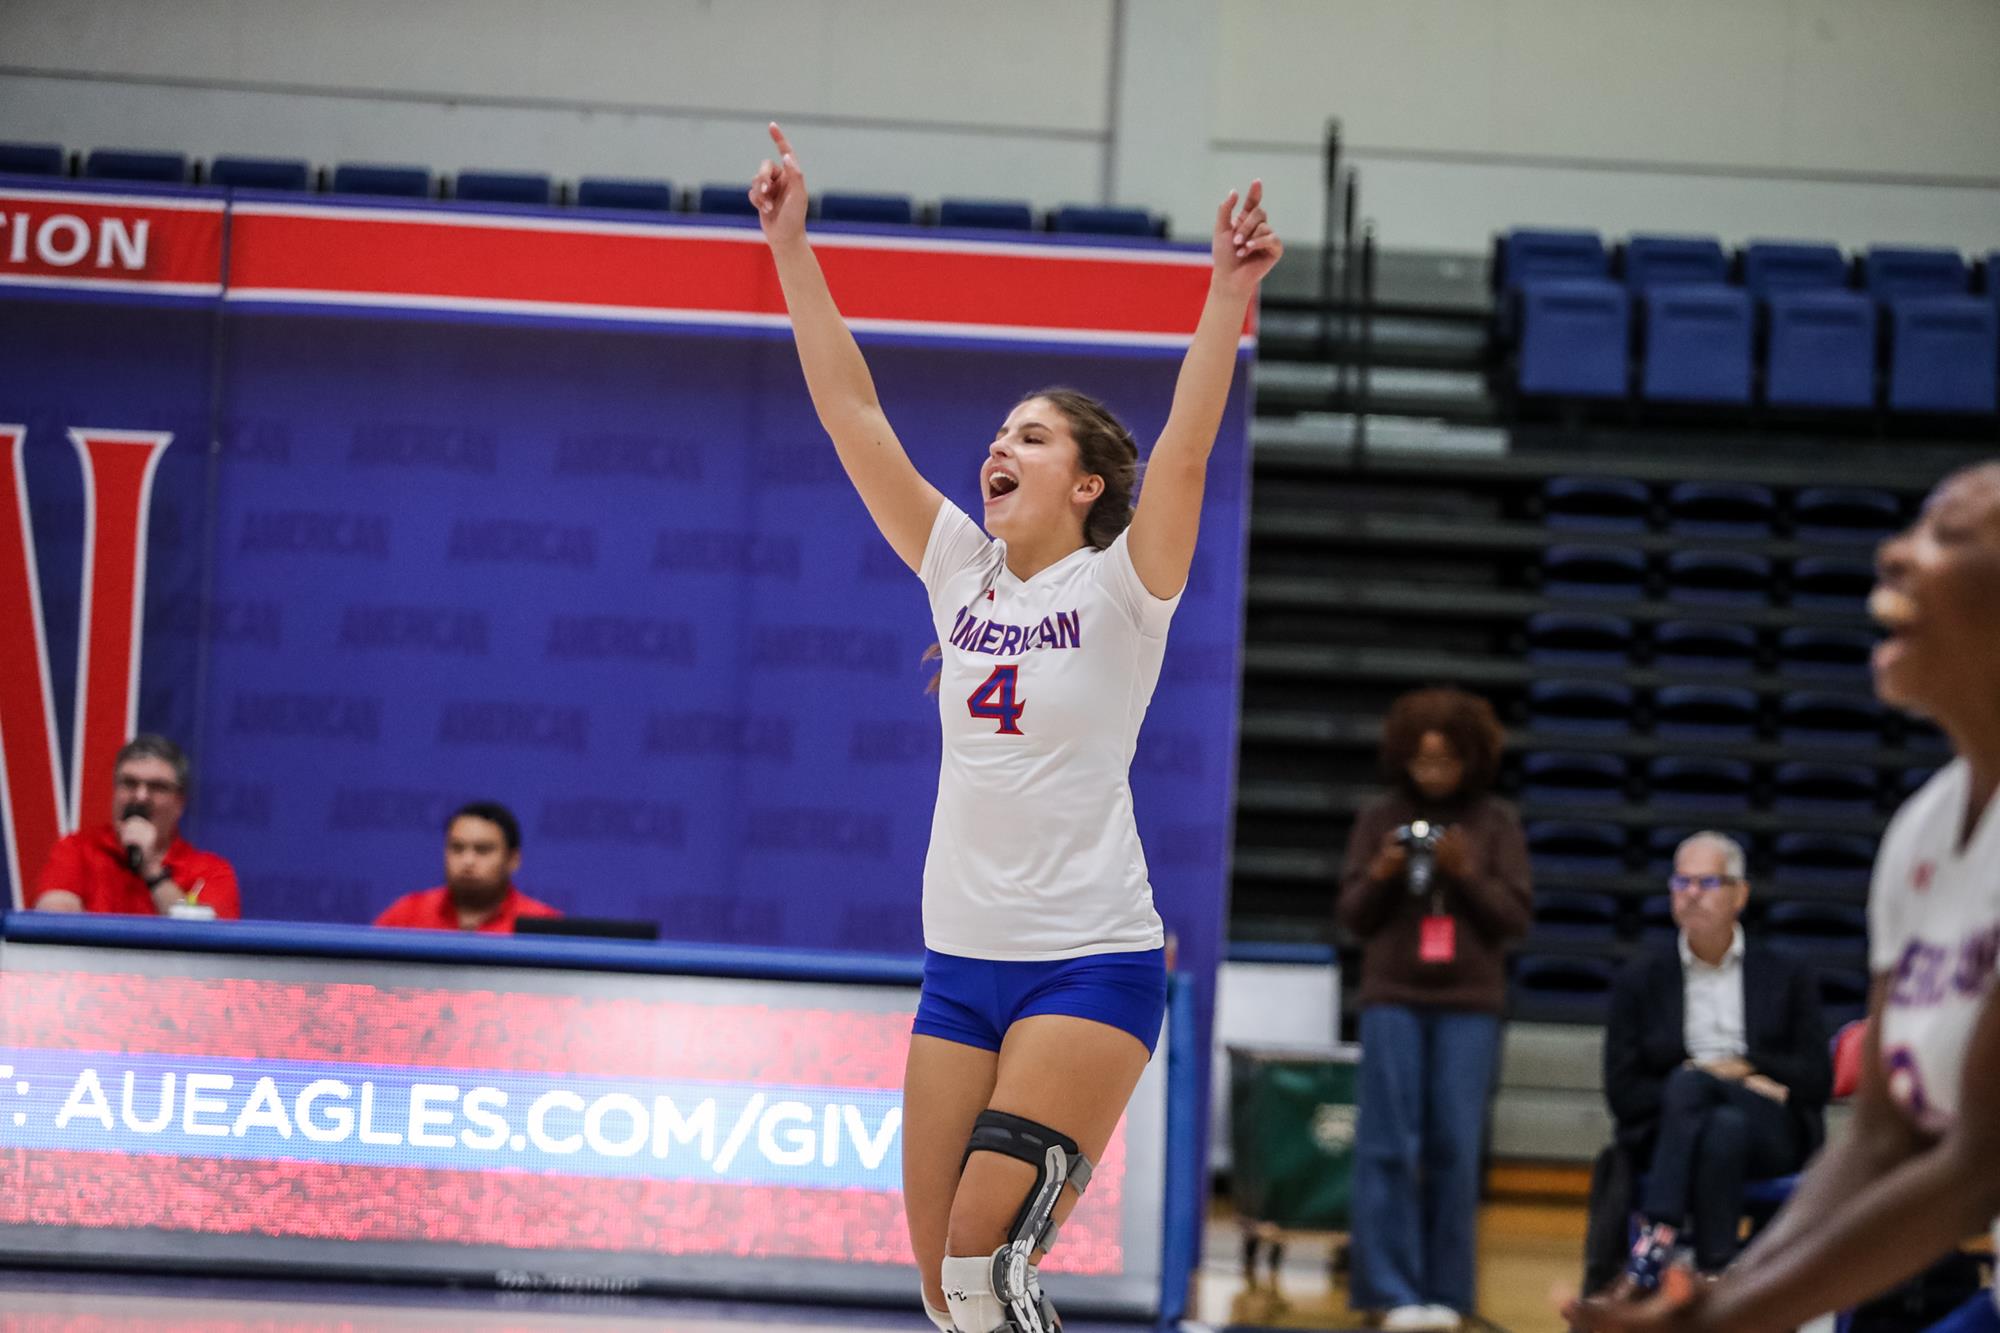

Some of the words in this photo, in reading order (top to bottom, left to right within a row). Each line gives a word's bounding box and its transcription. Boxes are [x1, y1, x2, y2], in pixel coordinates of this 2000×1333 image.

[0, 212, 150, 270] ION
[967, 664, 1027, 736] 4
[55, 1068, 903, 1174] AUEAGLES.COM/GIV
